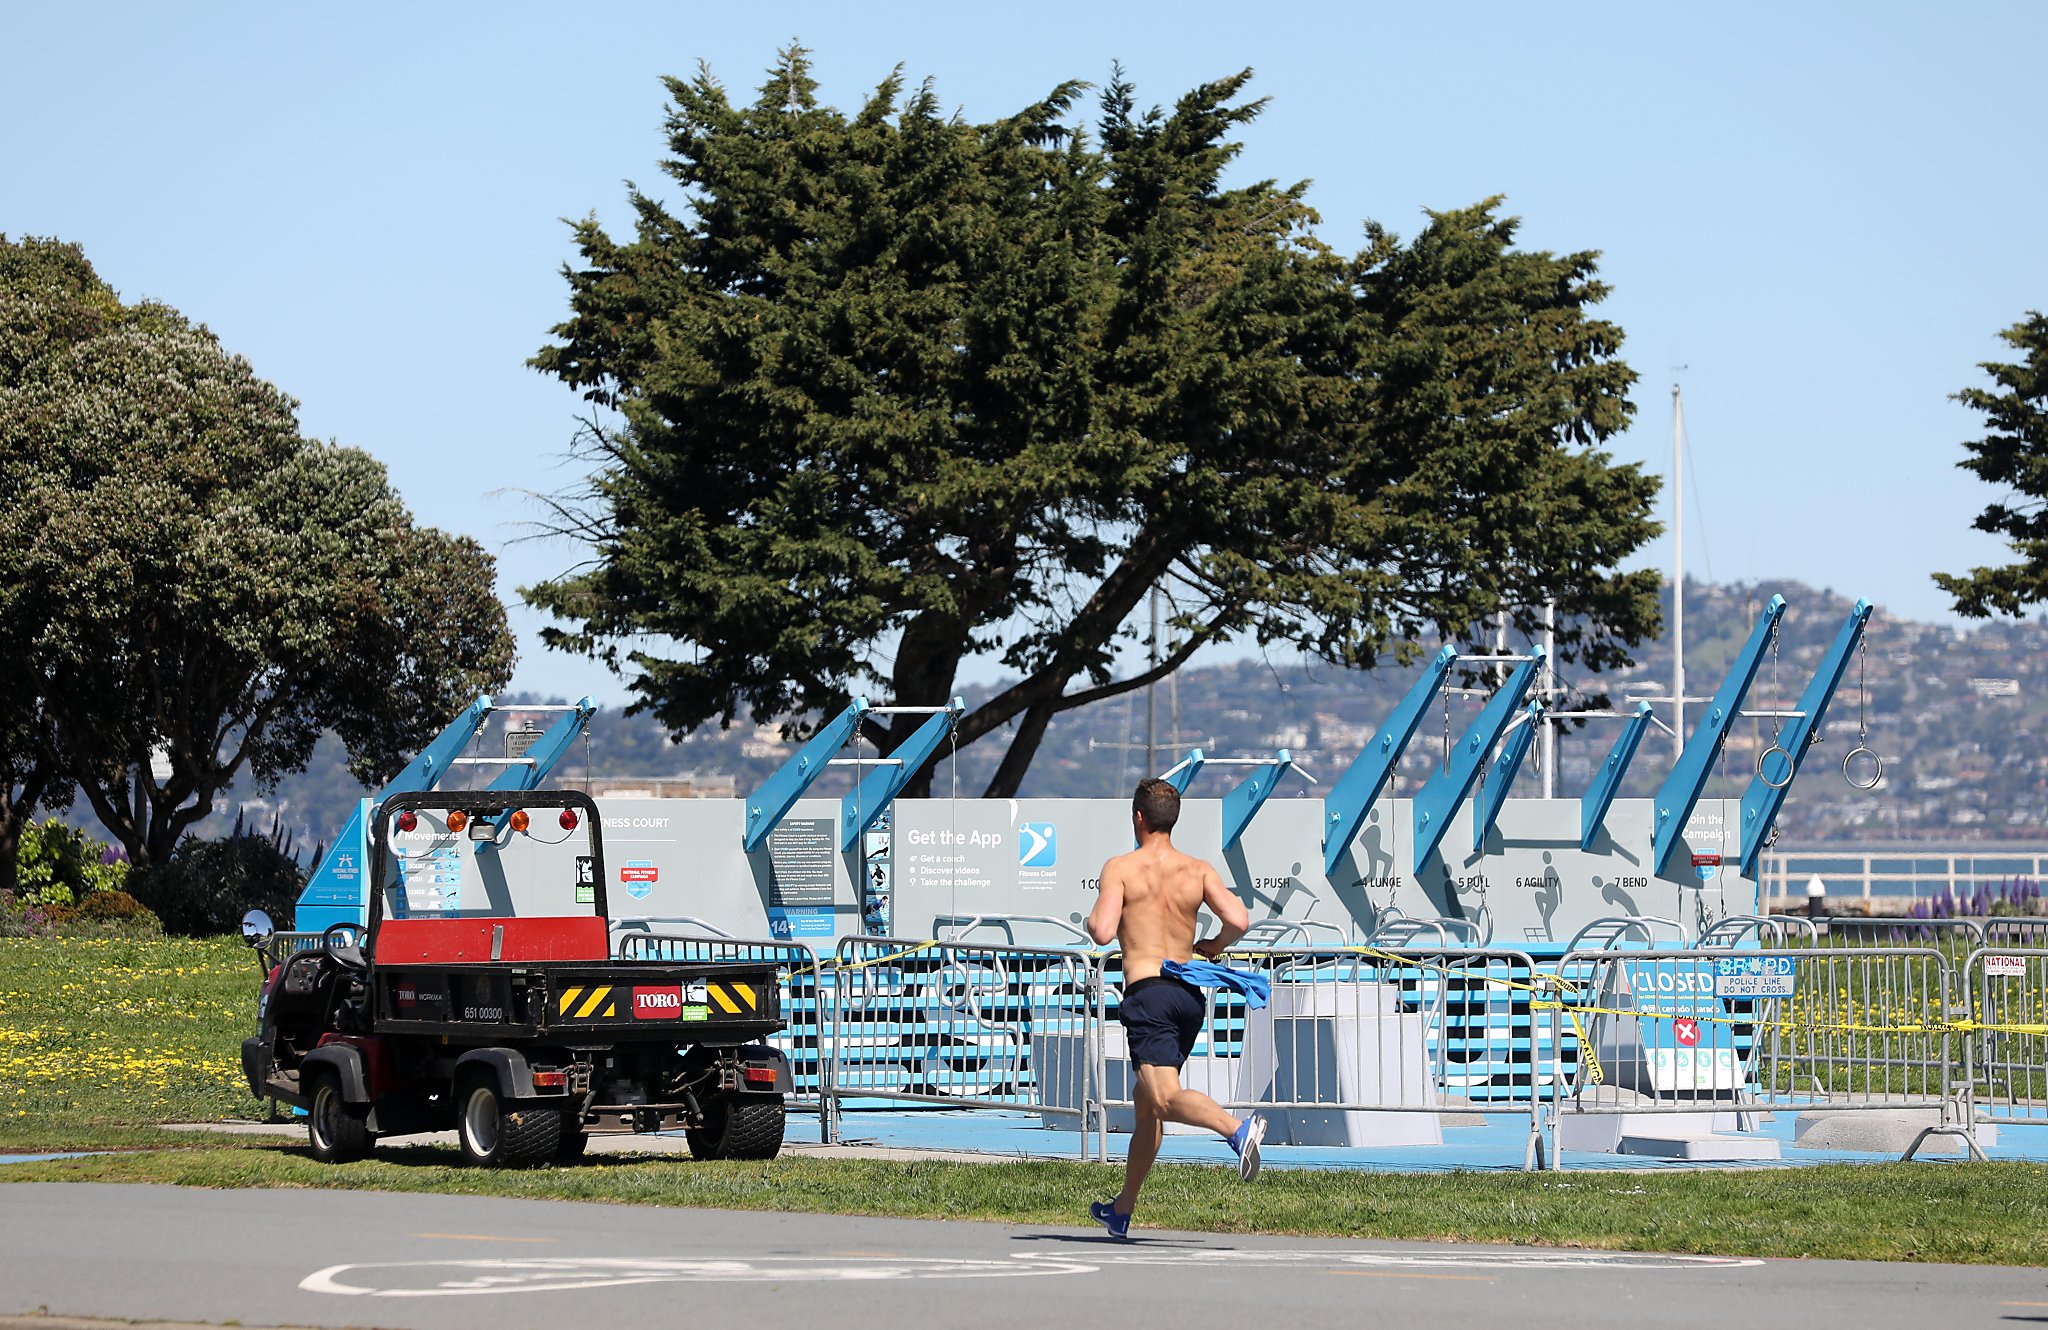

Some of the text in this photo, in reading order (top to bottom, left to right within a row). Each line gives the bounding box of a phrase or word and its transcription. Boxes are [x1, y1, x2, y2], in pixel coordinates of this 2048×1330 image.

[600, 818, 670, 828] TNESS COURT
[1690, 814, 1724, 824] oin the
[405, 832, 460, 840] Movements
[908, 830, 1001, 848] Get the App
[1682, 829, 1730, 841] Campaign
[954, 878, 990, 887] challenge
[1081, 879, 1100, 889] 1 CO
[1255, 878, 1290, 888] 3 PUSH
[1361, 878, 1368, 888] 4
[1459, 878, 1464, 887] 5
[1516, 878, 1559, 887] 6 AGILITY
[1615, 878, 1647, 887] 7 BEND
[771, 920, 796, 934] 14+
[1986, 958, 2024, 966] NATIONAL
[1632, 972, 1714, 992] CLOSED
[464, 1008, 502, 1019] 651 00300
